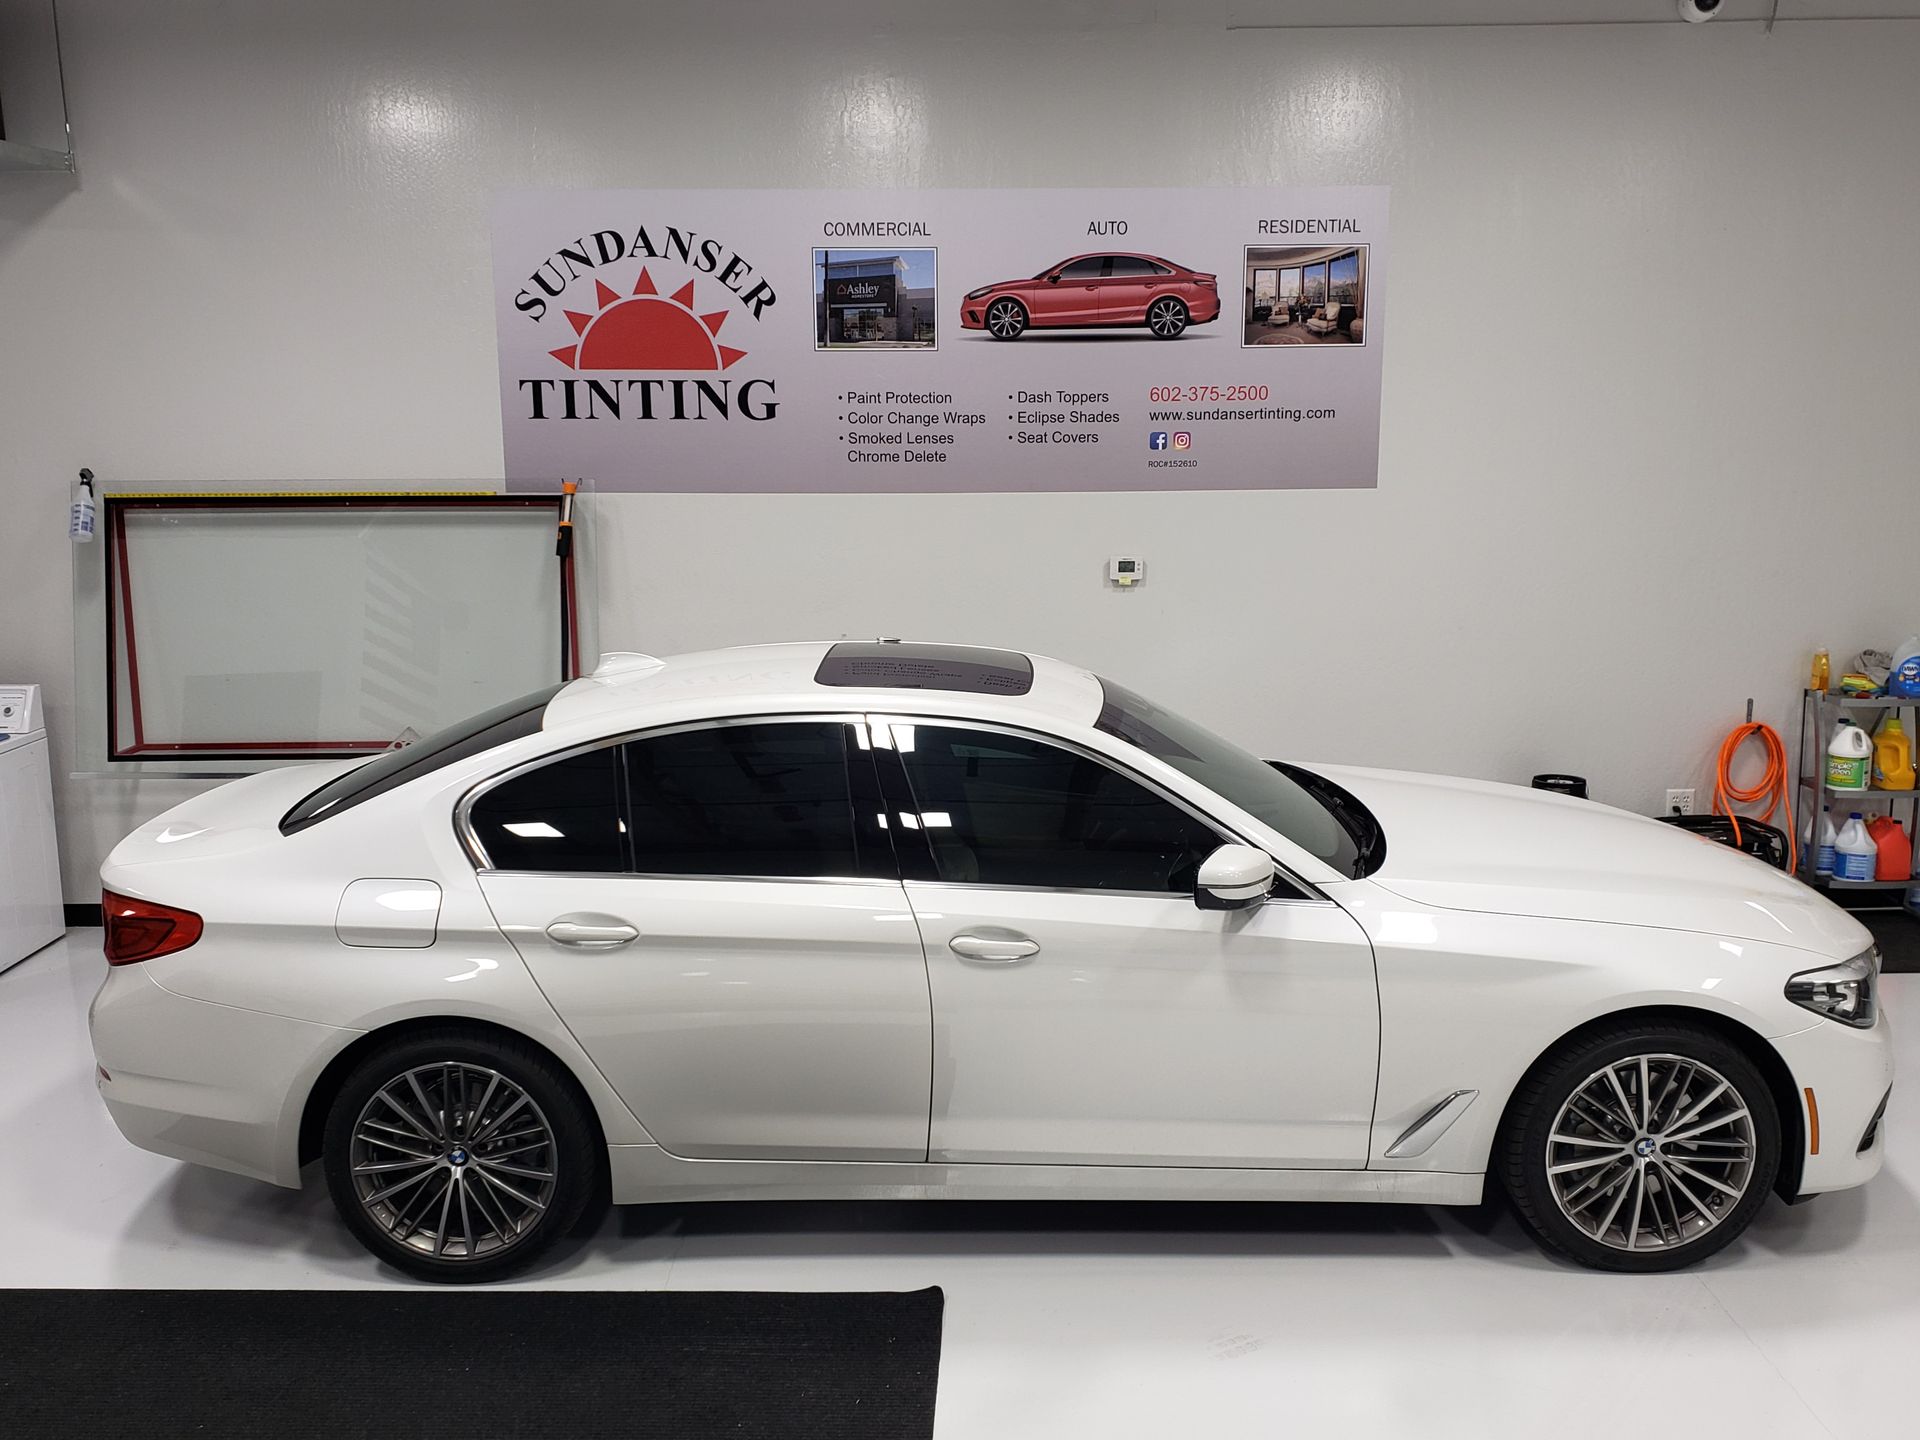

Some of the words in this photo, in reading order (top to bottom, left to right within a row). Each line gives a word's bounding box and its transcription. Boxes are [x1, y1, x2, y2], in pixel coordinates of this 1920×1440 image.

[823, 221, 932, 237] COMMERCIAL
[1086, 220, 1129, 236] AUTO
[1257, 218, 1362, 235] RESIDENTIAL
[514, 225, 777, 323] SUNDANSER
[846, 282, 880, 296] Ashley
[518, 378, 781, 421] TINTING
[847, 391, 882, 405] Paint
[885, 391, 953, 405] Protection
[1017, 390, 1052, 404] Dash
[1055, 390, 1110, 407] Toppers
[1149, 385, 1269, 402] 602-375-2500
[847, 411, 884, 425] Color
[887, 411, 940, 428] Change
[942, 411, 986, 428] Wraps
[1017, 410, 1066, 427] Eclipse
[1069, 410, 1120, 424] Shades
[1148, 406, 1336, 422] www.sundansertinting.com
[847, 431, 903, 445] Smoked
[906, 431, 955, 445] Lenses
[1017, 431, 1049, 444] Seat
[1051, 430, 1099, 444] Covers
[847, 449, 901, 463] Chrome
[904, 449, 947, 463] Delete
[1147, 459, 1198, 468] ROC#152610
